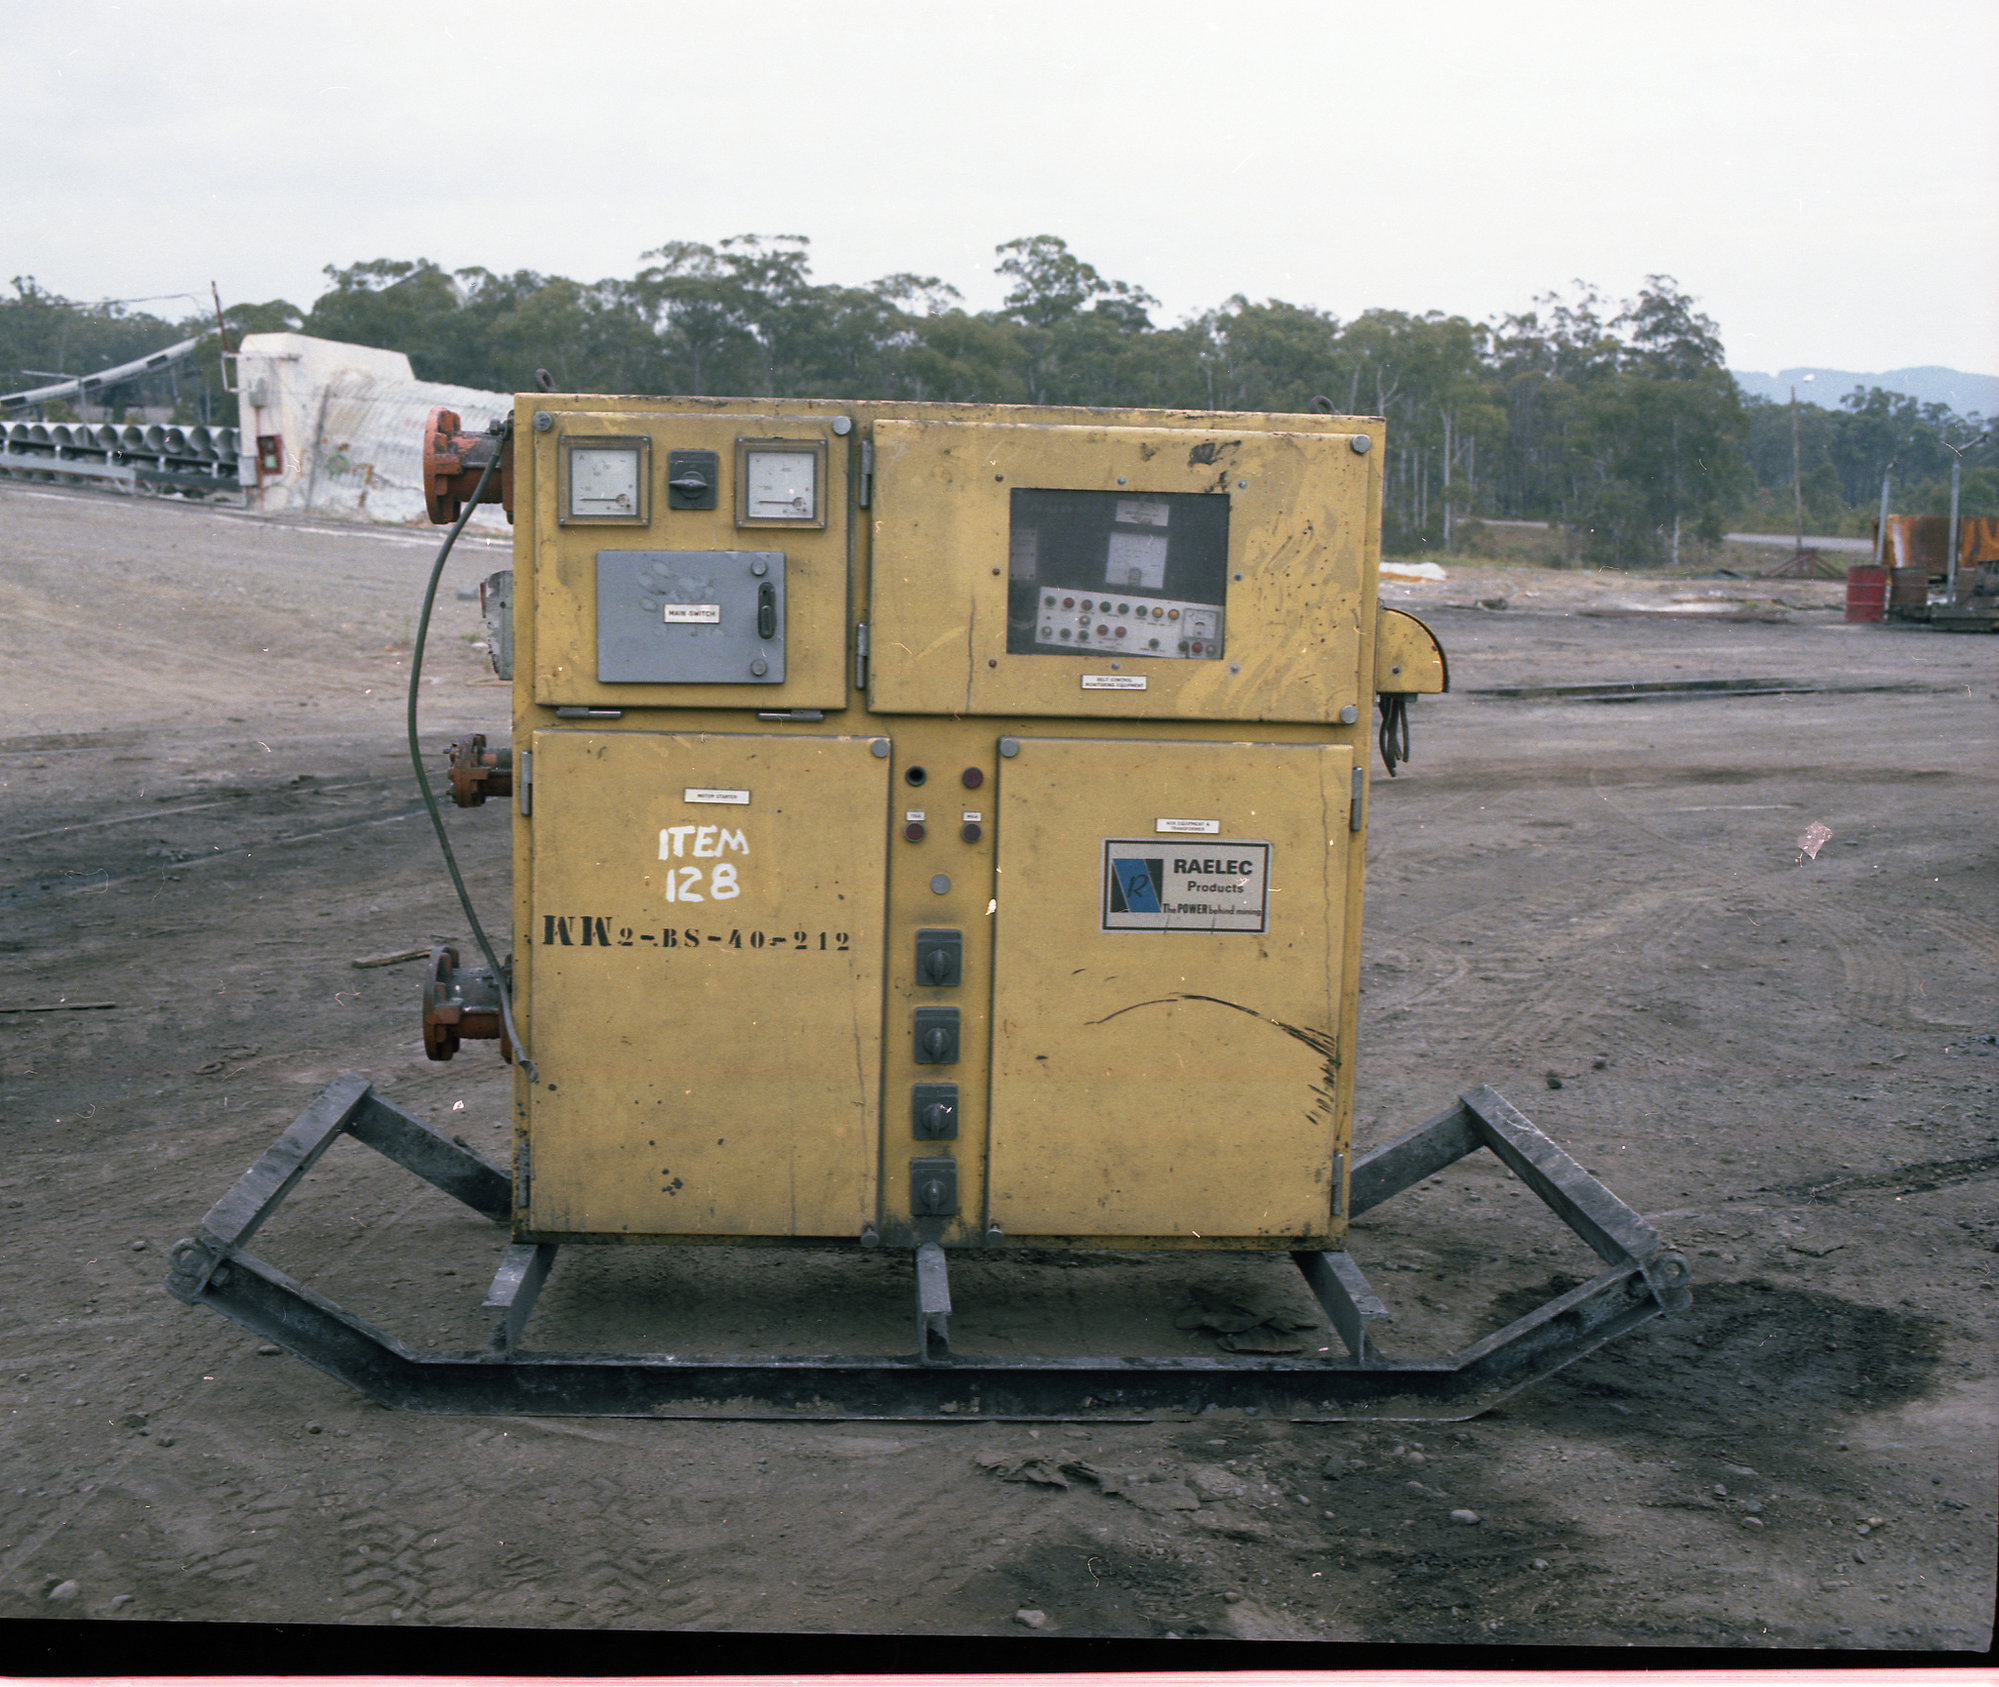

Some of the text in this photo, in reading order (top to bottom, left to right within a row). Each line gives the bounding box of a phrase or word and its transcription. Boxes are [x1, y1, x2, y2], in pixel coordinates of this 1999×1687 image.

[668, 609, 716, 617] MAIN SWITCH
[658, 825, 750, 860] ITEM
[1173, 858, 1254, 876] RAELEC
[666, 863, 741, 903] 128
[1187, 880, 1246, 894] Products
[1162, 903, 1177, 914] The
[1177, 903, 1208, 915] POWER
[1208, 904, 1235, 915] behind
